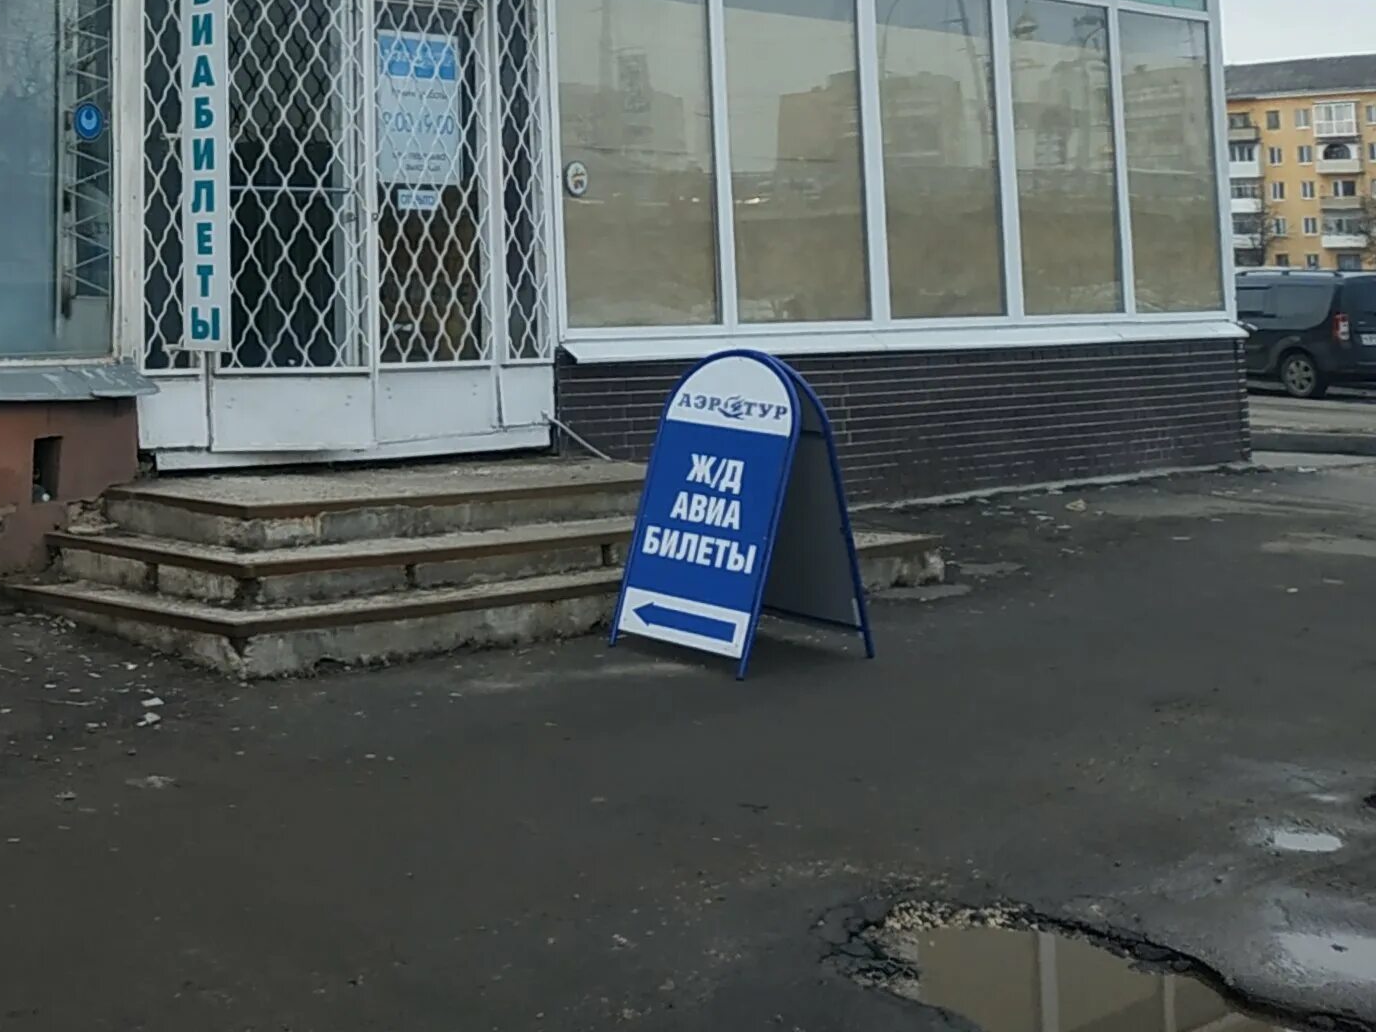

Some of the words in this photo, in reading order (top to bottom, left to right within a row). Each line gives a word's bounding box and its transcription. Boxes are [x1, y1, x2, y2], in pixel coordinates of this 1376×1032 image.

[686, 453, 745, 496] Ж/Д
[670, 491, 741, 530] АВИА
[642, 525, 758, 575] БИЛЕТЫ
